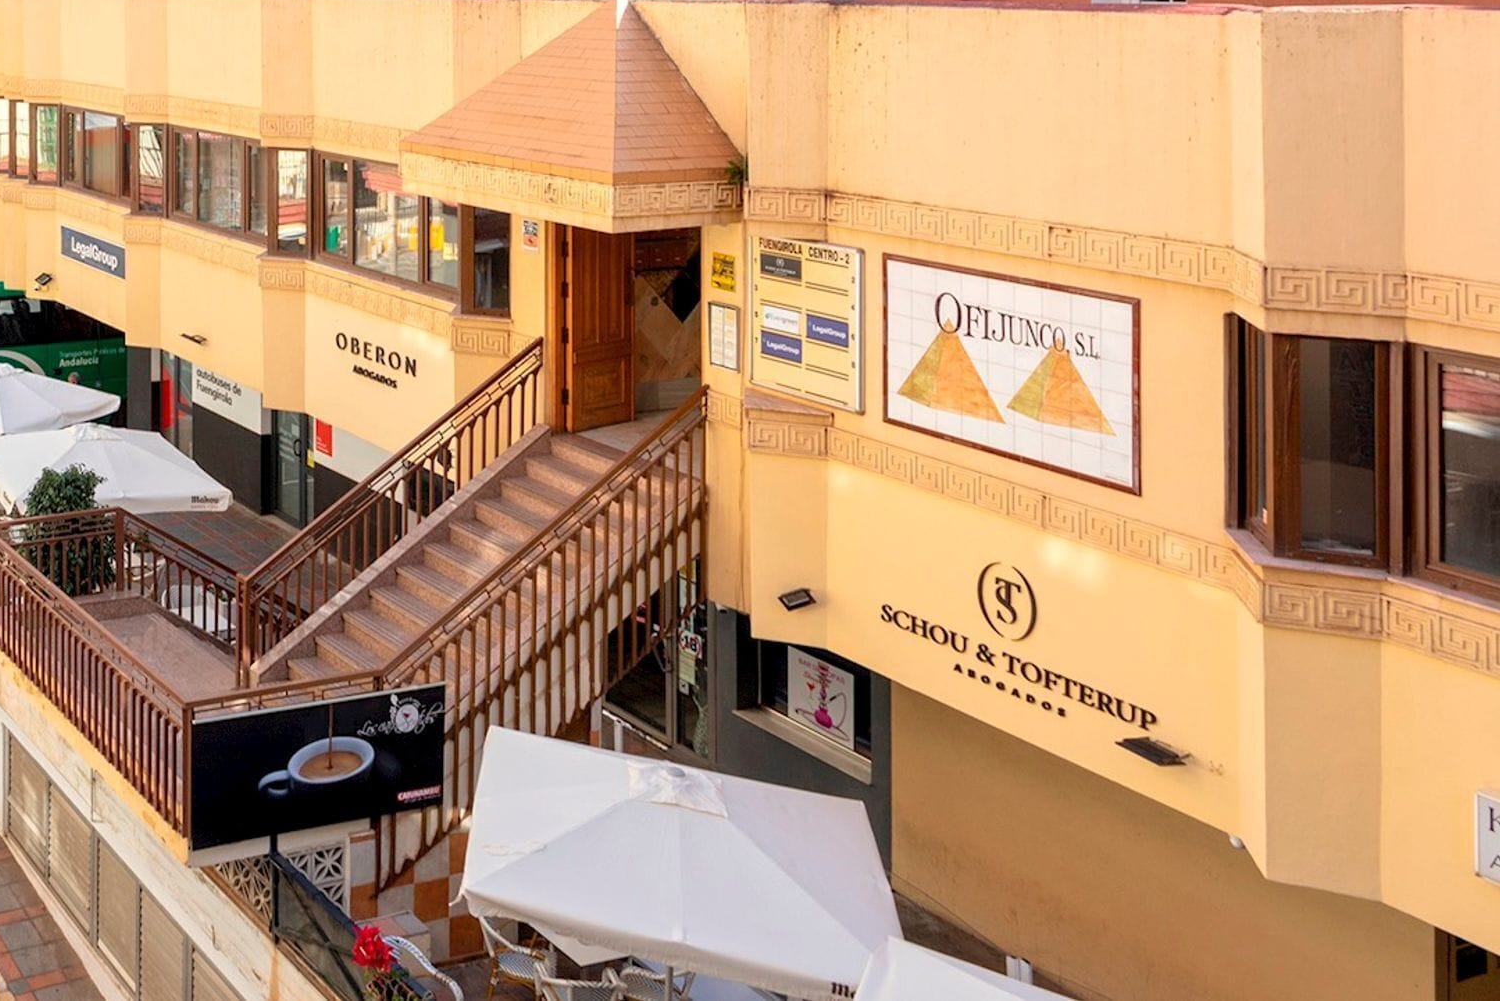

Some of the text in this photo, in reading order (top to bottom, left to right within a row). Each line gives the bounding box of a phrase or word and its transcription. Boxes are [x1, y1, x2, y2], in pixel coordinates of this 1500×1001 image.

[71, 236, 119, 271] LegalGroup
[759, 237, 803, 255] FUENGIROLA
[812, 323, 847, 340] LegalGroup
[335, 332, 417, 377] OBERON
[766, 339, 800, 356] LegalGroup
[196, 368, 242, 397] autobuses de
[352, 364, 398, 389] ABOGADOS
[196, 379, 233, 406] Fuengirola
[880, 603, 1158, 732] SCHOU & TOFTERUP
[953, 663, 1067, 718] ABOGADOS
